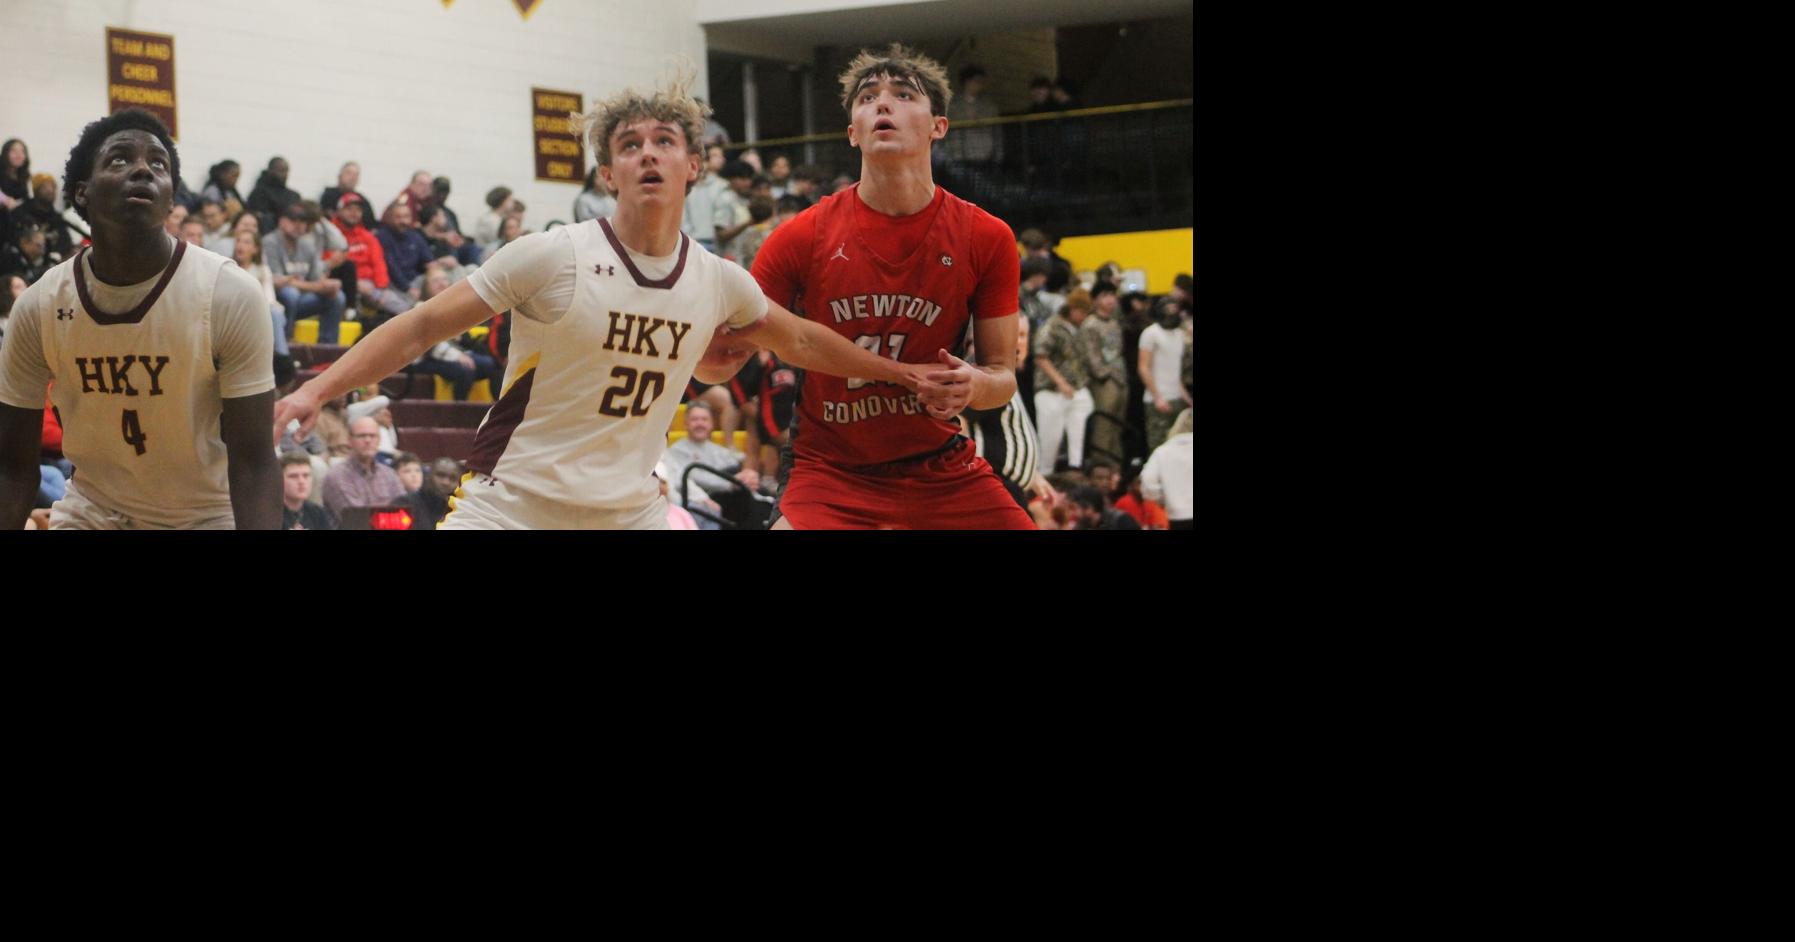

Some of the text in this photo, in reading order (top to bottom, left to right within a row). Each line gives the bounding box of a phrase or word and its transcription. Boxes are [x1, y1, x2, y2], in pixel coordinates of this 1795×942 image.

[111, 37, 170, 60] TEAM AND
[121, 61, 158, 81] CHEER
[111, 84, 174, 107] PERSONNEL
[539, 138, 579, 156] SECTION
[547, 160, 573, 178] ONLY
[829, 294, 942, 327] NEWTON
[602, 310, 691, 360] HKY
[75, 354, 169, 396] HKY
[598, 366, 665, 418] 20
[121, 408, 146, 456] 4
